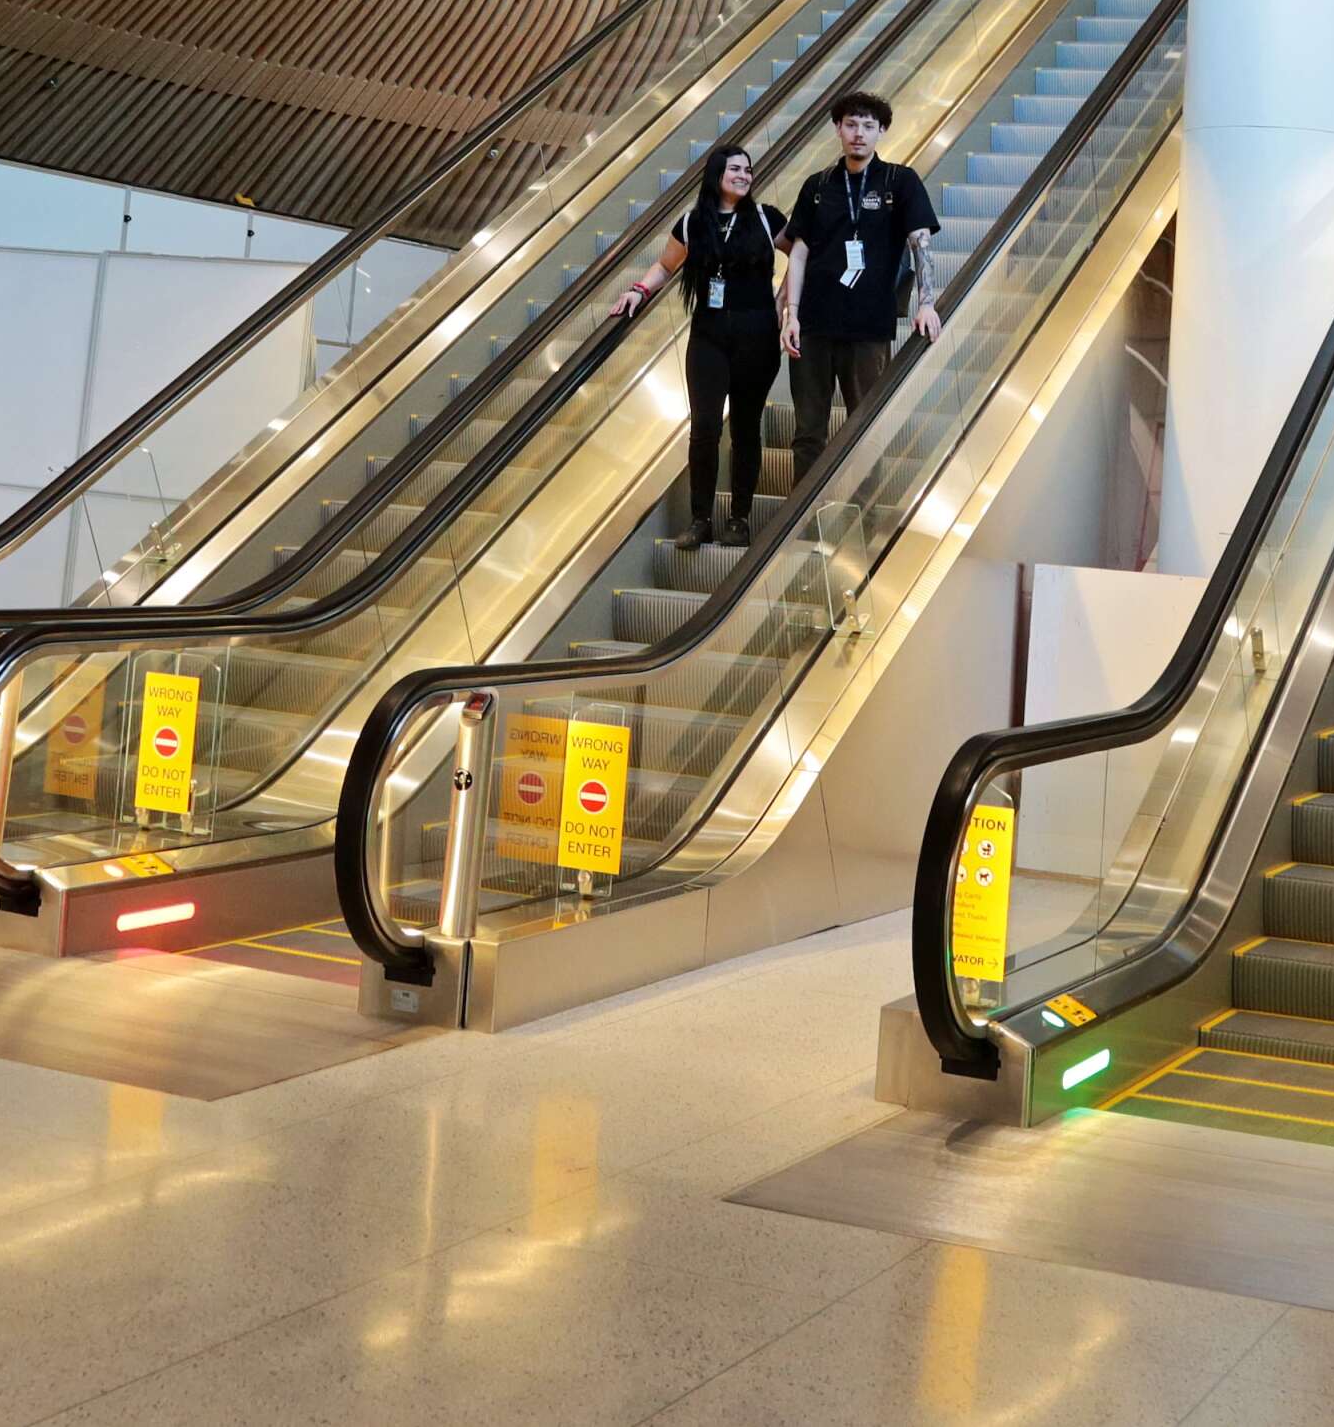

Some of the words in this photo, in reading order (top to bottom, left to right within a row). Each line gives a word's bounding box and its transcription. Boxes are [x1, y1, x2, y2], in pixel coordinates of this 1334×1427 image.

[148, 686, 194, 703] WRONG
[156, 704, 182, 719] WAY
[571, 736, 624, 754] WRONG
[582, 756, 611, 771] WAY
[141, 765, 159, 779] DO
[162, 767, 187, 782] NOT
[143, 784, 181, 799] ENTER
[565, 820, 586, 835] DO
[589, 823, 618, 839] NOT
[972, 816, 1006, 831] TION
[567, 843, 612, 858] ENTER
[953, 954, 985, 967] VATOR
